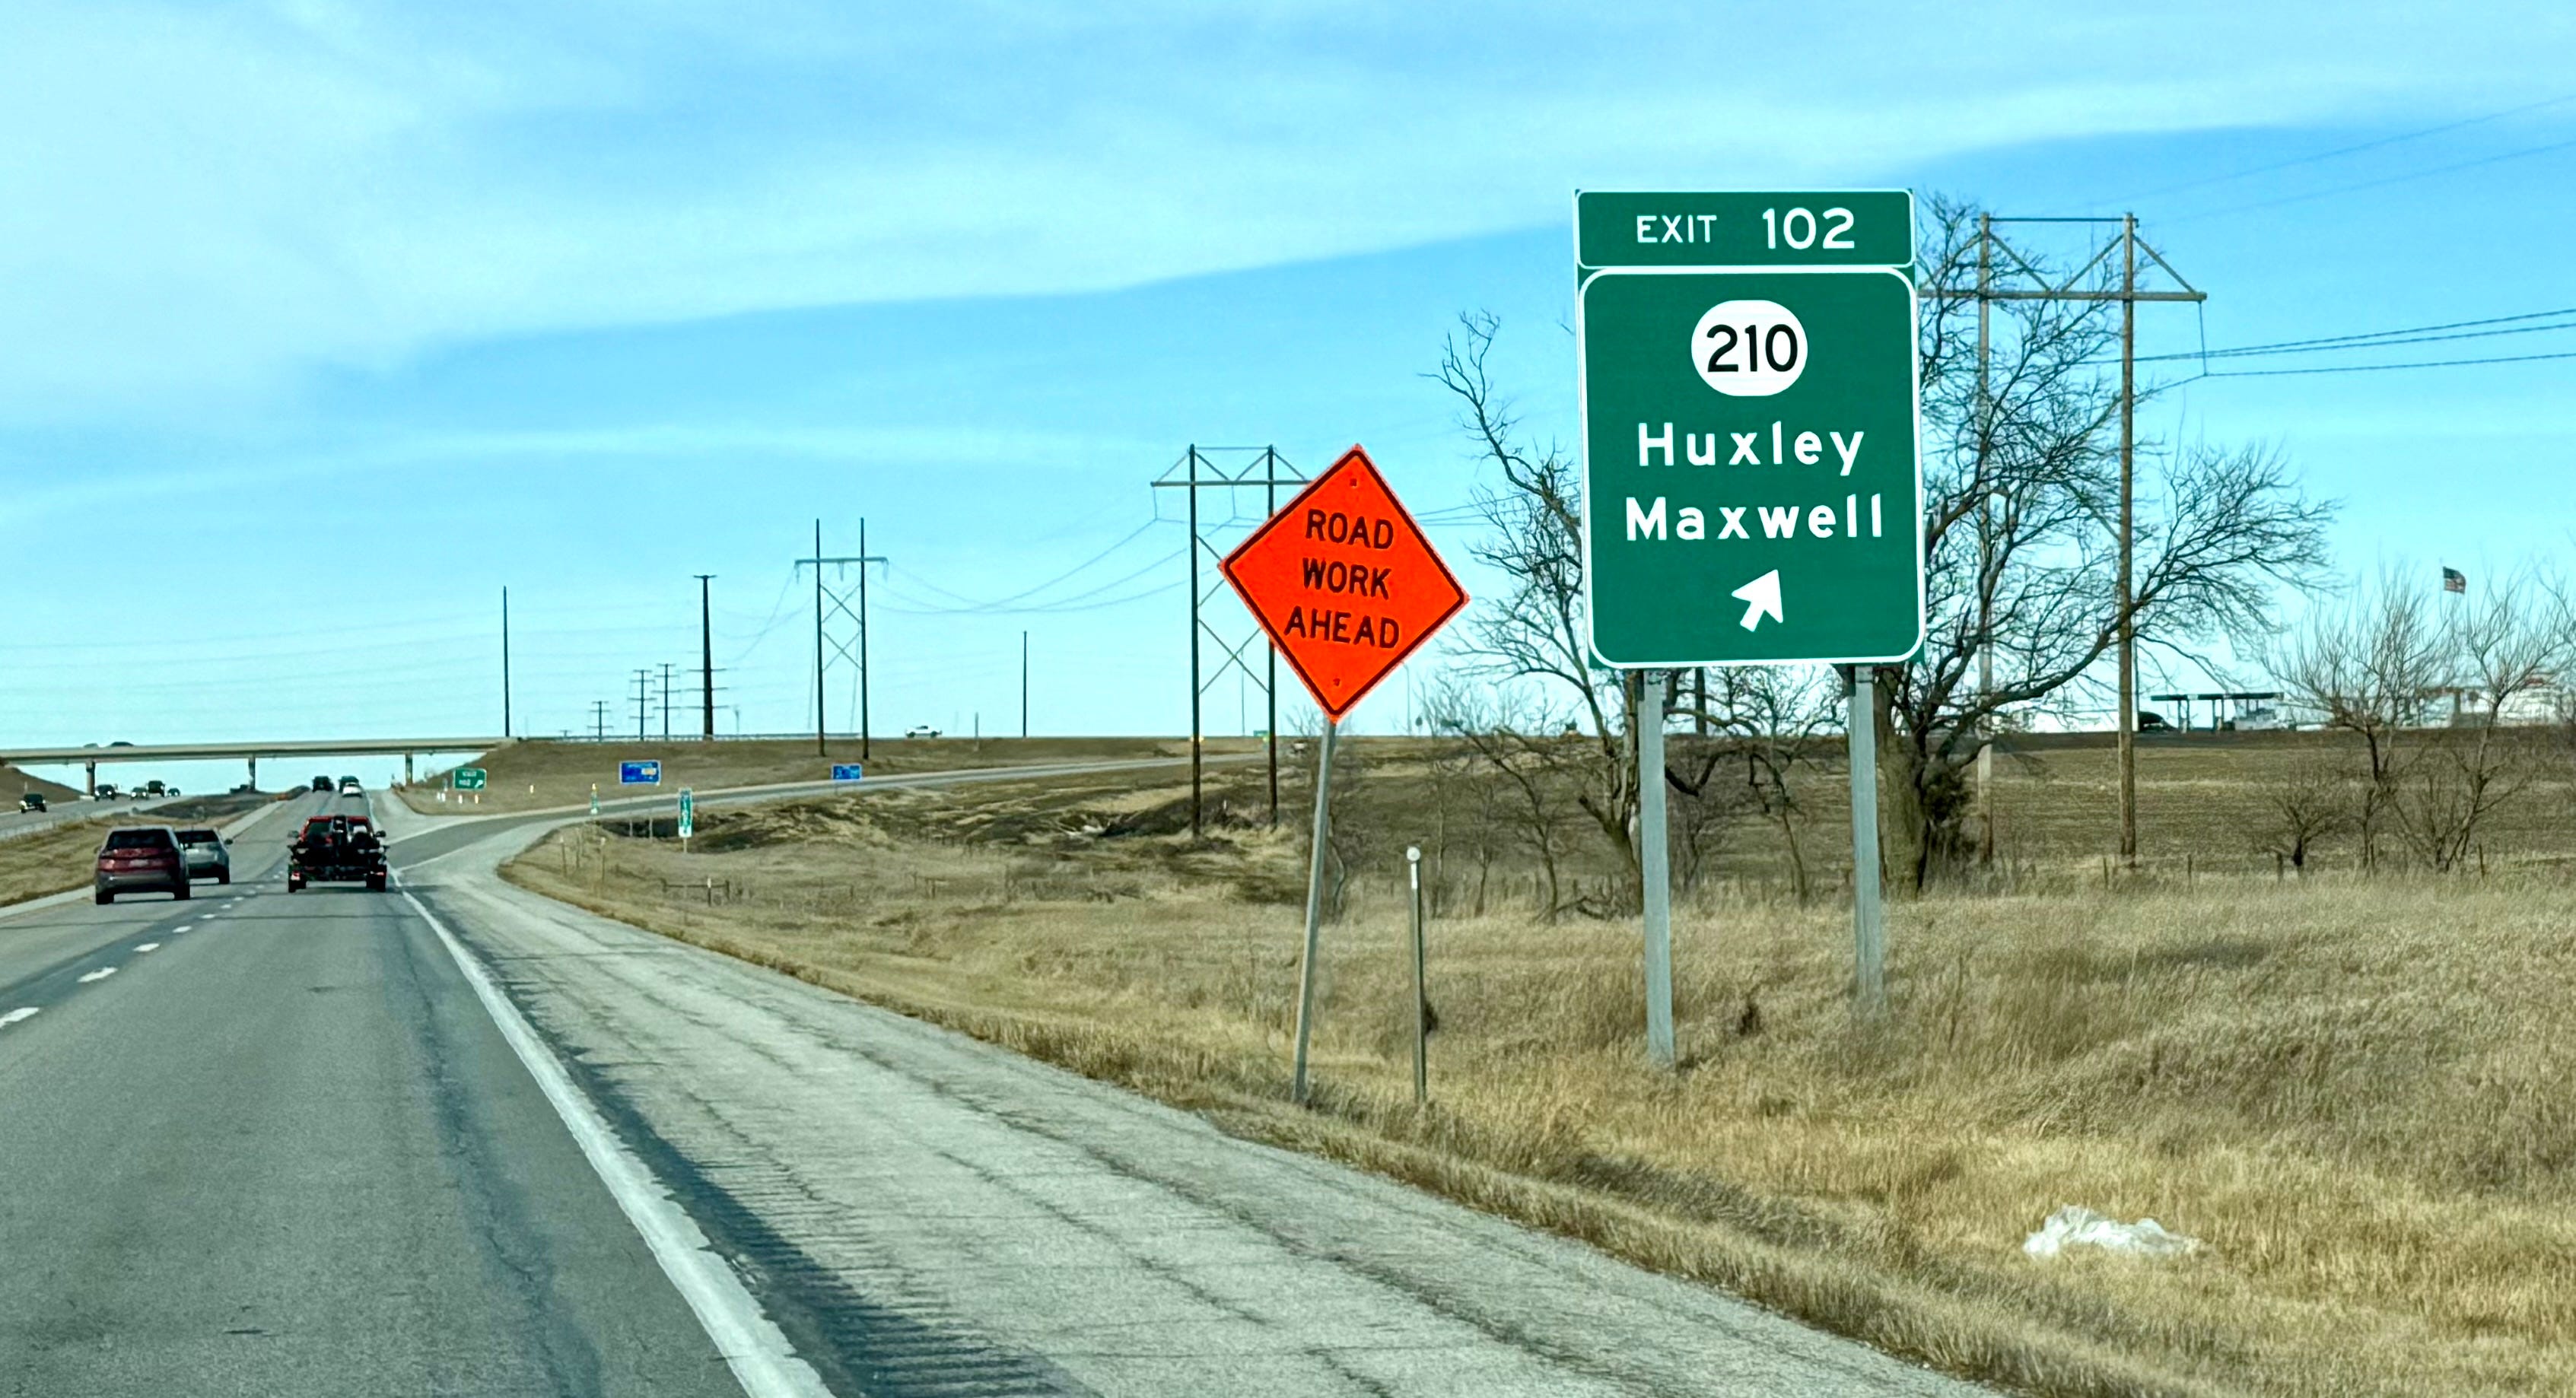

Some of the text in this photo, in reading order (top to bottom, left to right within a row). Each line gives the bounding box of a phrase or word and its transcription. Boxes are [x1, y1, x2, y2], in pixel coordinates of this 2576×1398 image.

[1636, 207, 1855, 249] EXIT 102
[1706, 324, 1798, 372] 210
[1638, 421, 1864, 476] Huxley
[1305, 508, 1395, 549] ROAD
[1626, 494, 1881, 541] Maxwell
[1302, 557, 1391, 599] WORK
[1283, 606, 1400, 650] AHEAD
